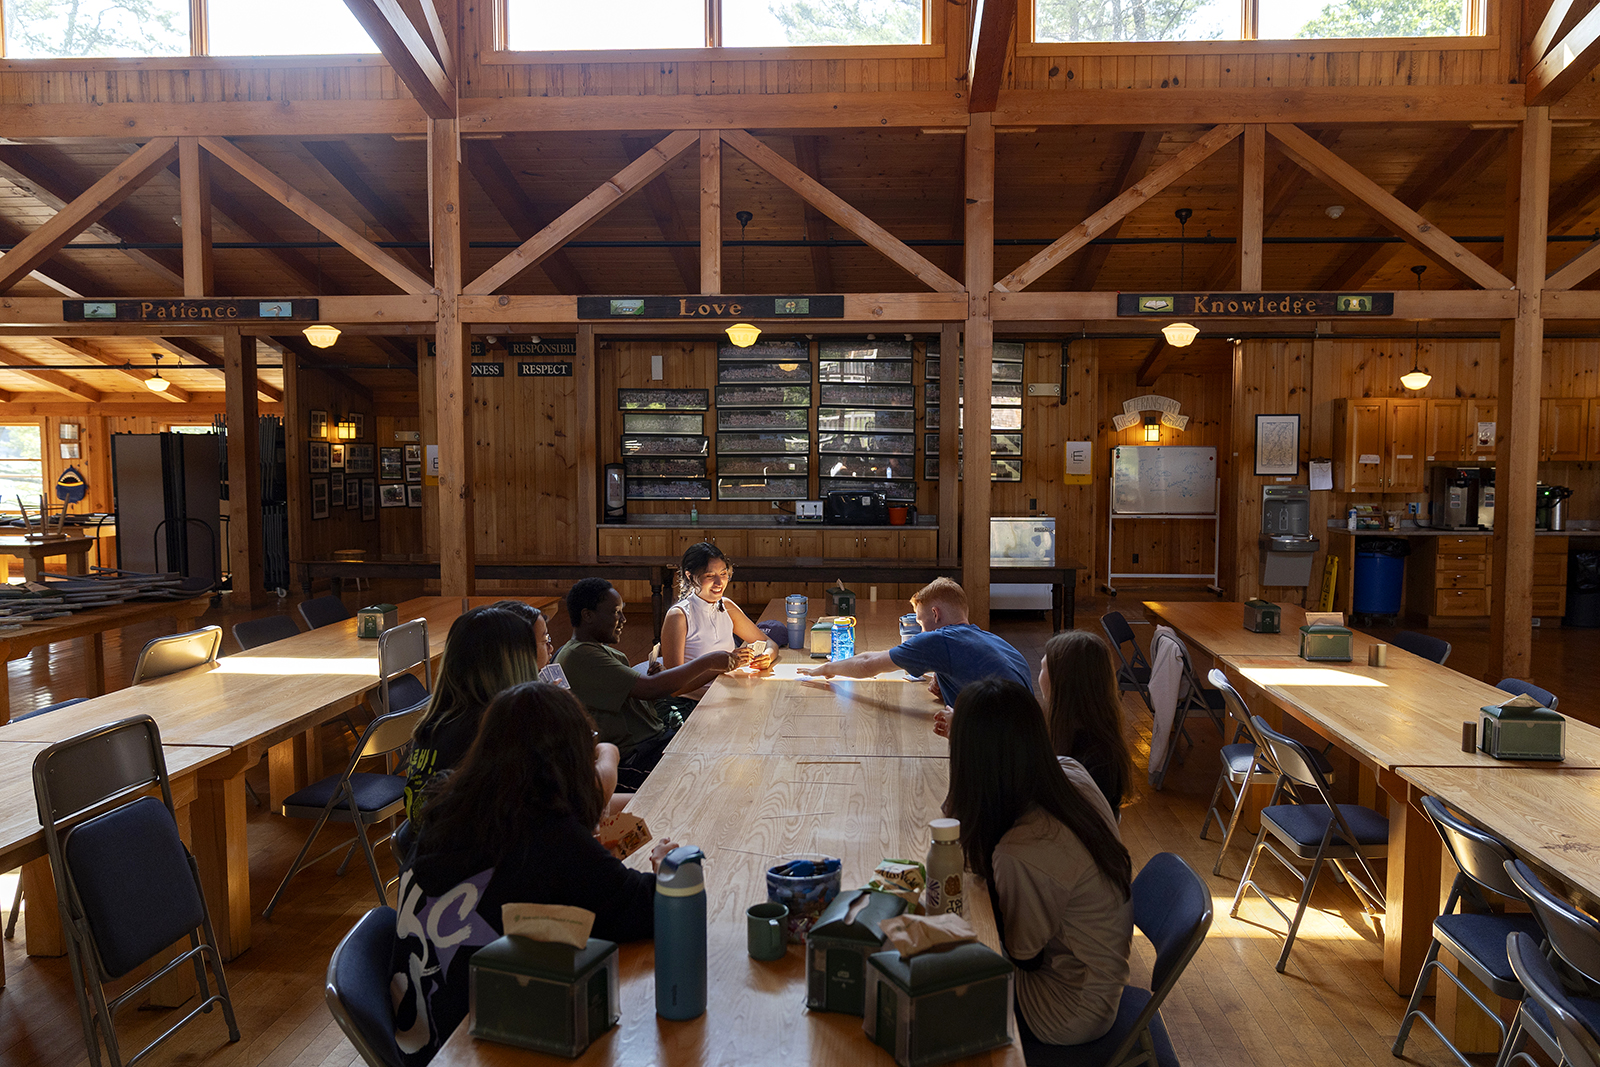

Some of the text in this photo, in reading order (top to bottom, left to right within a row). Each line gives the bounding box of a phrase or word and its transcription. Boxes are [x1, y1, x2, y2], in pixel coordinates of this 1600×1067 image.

[141, 302, 238, 318] Patience
[679, 299, 742, 316] Love
[1194, 296, 1317, 314] Knowledge
[513, 343, 577, 354] RESPONSIBIL
[522, 364, 568, 375] RESPECT
